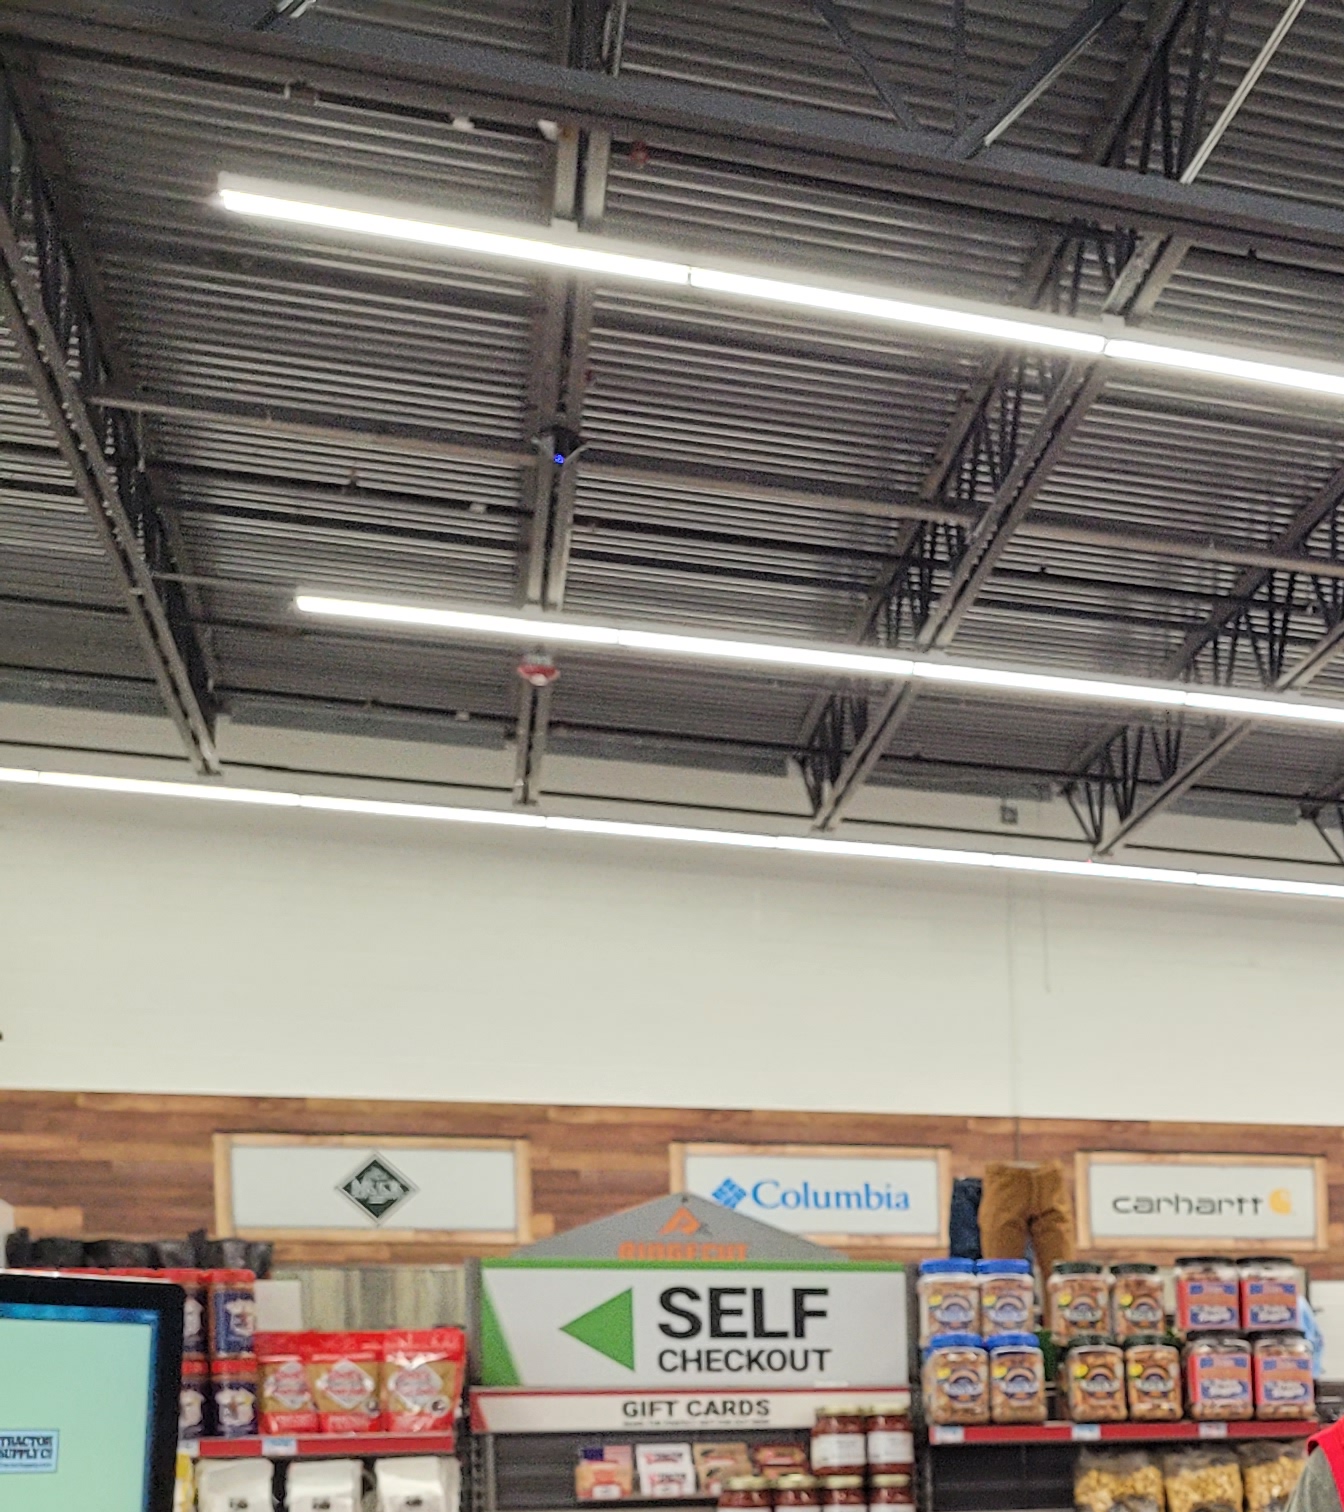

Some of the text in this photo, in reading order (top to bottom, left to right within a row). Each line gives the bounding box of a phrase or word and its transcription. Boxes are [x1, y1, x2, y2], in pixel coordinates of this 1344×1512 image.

[752, 1181, 911, 1211] Columbia
[1112, 1192, 1264, 1217] carhartt
[658, 1286, 829, 1339] SELF
[658, 1348, 832, 1372] CHECKOUT
[622, 1400, 770, 1418] GIFT CARDS
